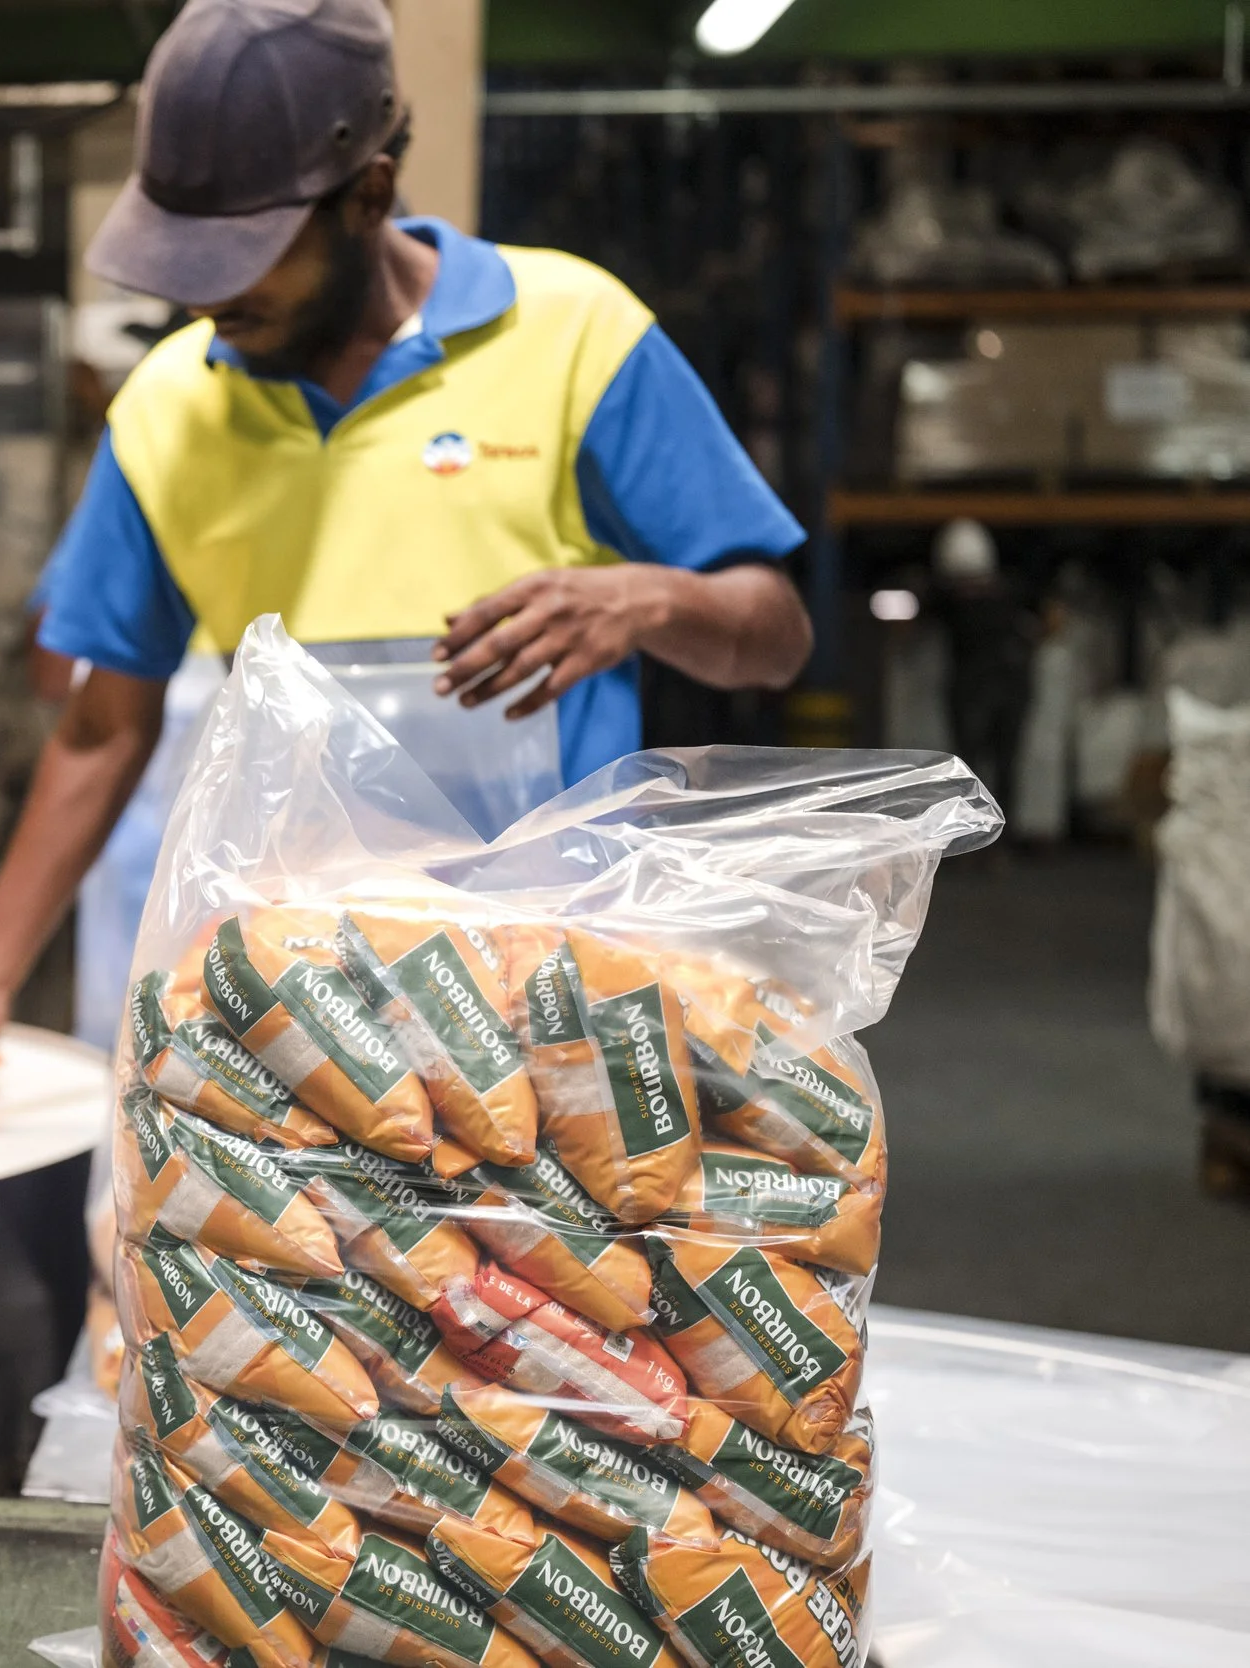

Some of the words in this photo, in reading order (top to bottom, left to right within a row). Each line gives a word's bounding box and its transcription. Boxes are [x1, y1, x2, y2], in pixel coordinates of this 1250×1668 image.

[302, 997, 317, 1012] DE
[422, 950, 512, 1066] BOURBON
[426, 978, 440, 995] DE
[297, 966, 399, 1074] BOURBON
[439, 997, 485, 1055] SUCRERIES
[621, 1029, 629, 1046] DE
[187, 1024, 292, 1101] BOURBON
[208, 1059, 266, 1099] SUCRERIES
[624, 1002, 674, 1136] BOURBON
[625, 1050, 649, 1119] SUCRERIES
[345, 1143, 432, 1223] BOURBO
[534, 1150, 612, 1234] BOURB
[715, 1167, 841, 1201] BOURBON
[235, 1278, 247, 1295] DE
[339, 1287, 354, 1300] DE
[345, 1271, 433, 1342] BOURBO
[500, 1281, 513, 1297] DE
[517, 1291, 532, 1308] LA
[729, 1300, 743, 1316] DE
[725, 1268, 822, 1382] BOURBON
[745, 1319, 793, 1375] SUCRERIES
[232, 1427, 246, 1442] DE
[366, 1419, 480, 1486] BOURBON
[436, 1419, 495, 1467] URBON
[551, 1419, 669, 1495] BOURBON
[737, 1427, 846, 1505] BOURBON
[749, 1461, 764, 1473] DE
[199, 1518, 211, 1534] DE
[213, 1535, 257, 1594] SUCRERIES
[366, 1552, 485, 1628] BOURBON
[378, 1584, 393, 1597] DE
[398, 1592, 461, 1629] SUCRERIES
[536, 1559, 651, 1660] BOURBON
[545, 1593, 560, 1608] DE
[807, 1578, 862, 1668] UCRE
[563, 1607, 621, 1656] SUCRERIES
[711, 1597, 776, 1668] URBON
[714, 1628, 729, 1646] DE
